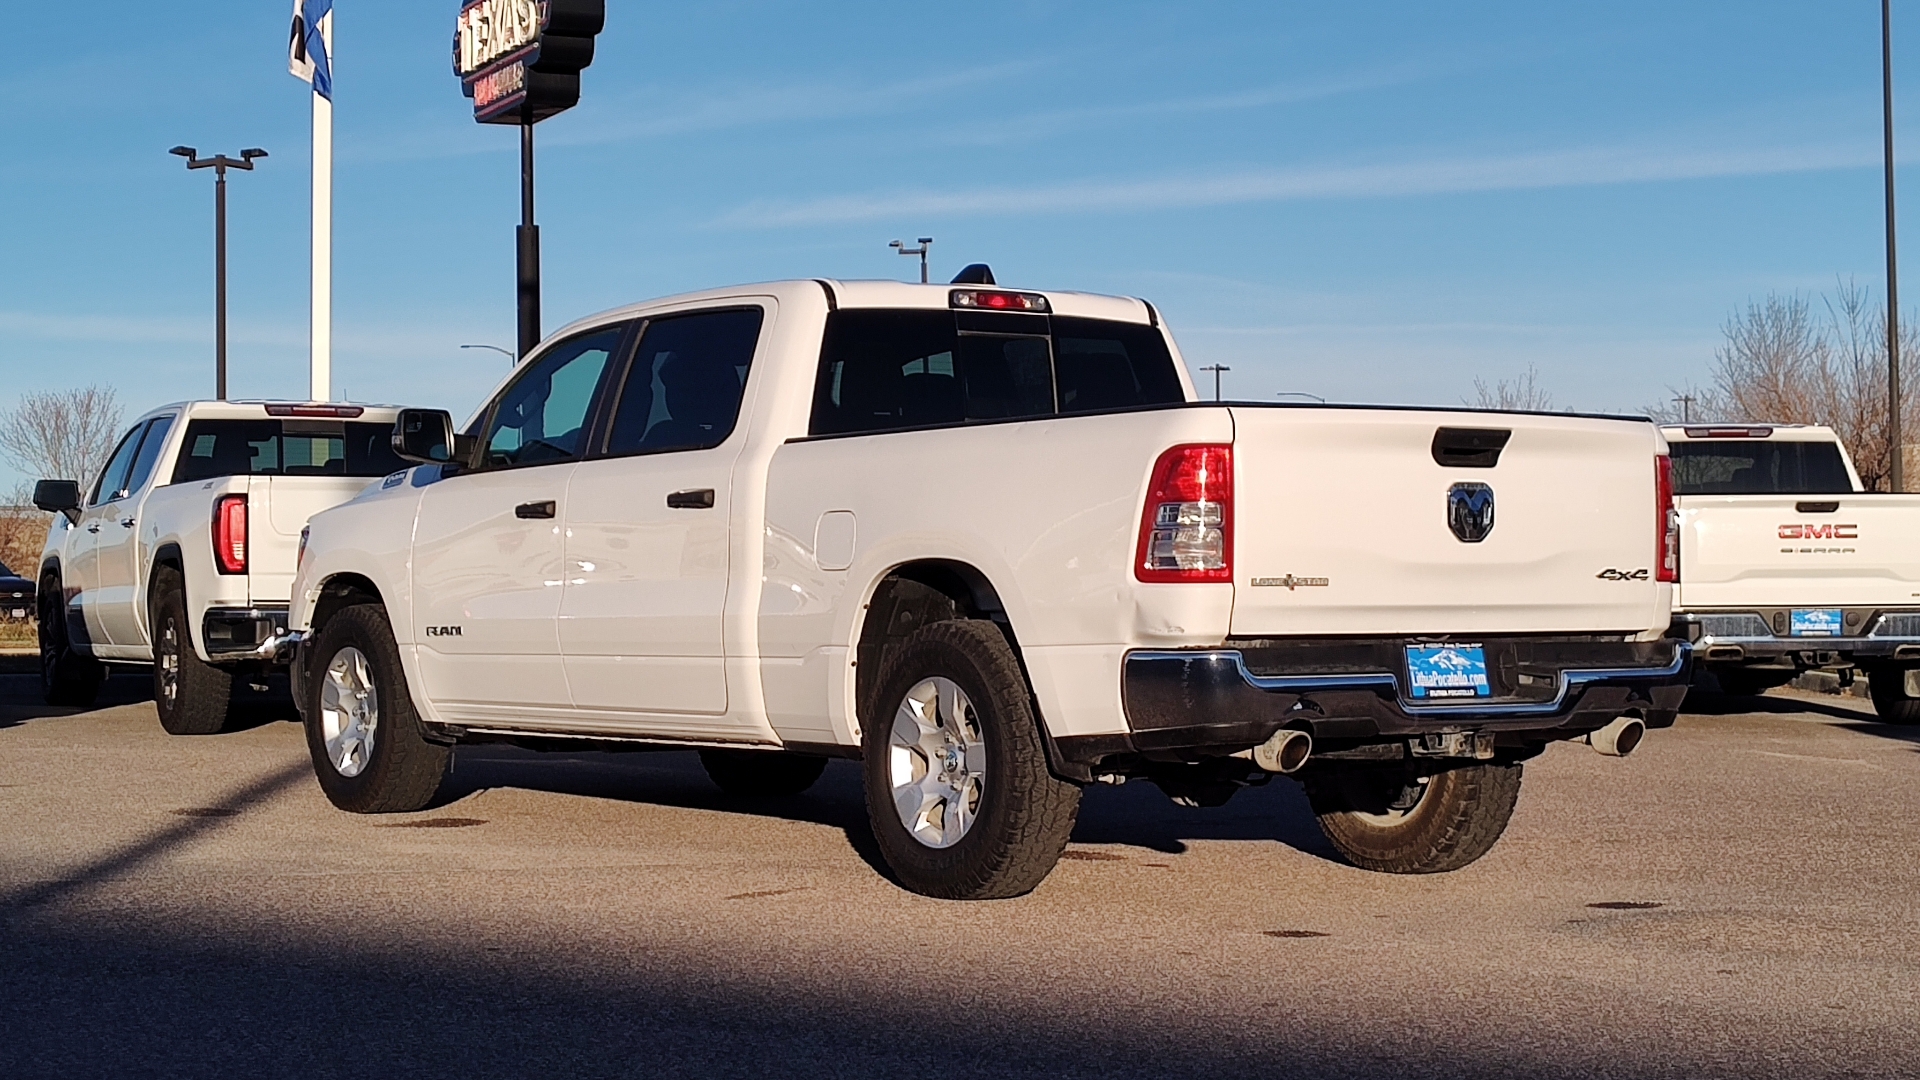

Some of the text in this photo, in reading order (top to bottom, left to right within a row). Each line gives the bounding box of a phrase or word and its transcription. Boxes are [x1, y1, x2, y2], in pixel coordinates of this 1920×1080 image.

[457, 0, 541, 73] TEXAS
[1778, 524, 1858, 539] GMC
[426, 625, 463, 637] RAM
